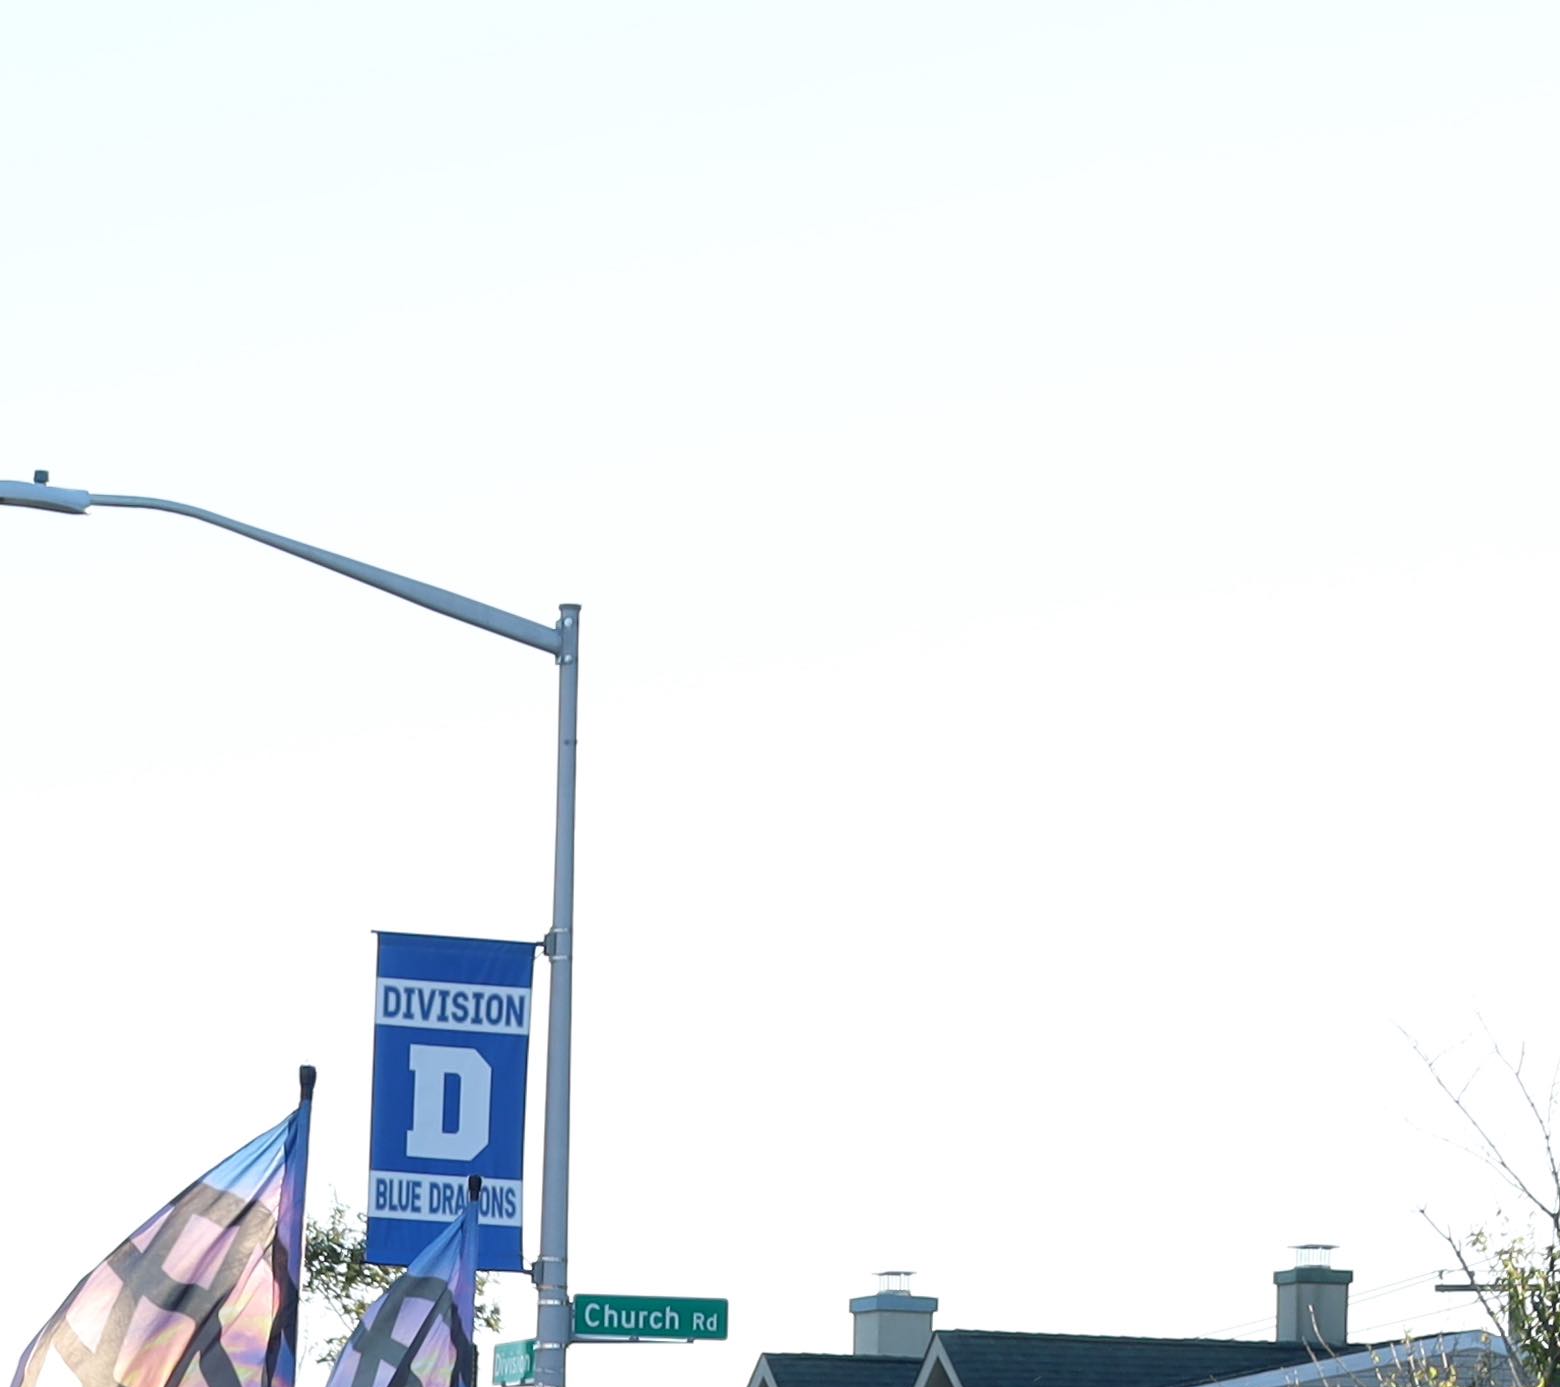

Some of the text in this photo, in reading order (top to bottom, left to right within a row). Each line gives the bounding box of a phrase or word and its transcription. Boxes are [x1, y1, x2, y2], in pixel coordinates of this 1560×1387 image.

[382, 984, 526, 1028] DIVISION
[406, 1043, 492, 1161] D
[374, 1177, 422, 1213] BLUE
[584, 1303, 718, 1332] Church Rd
[495, 1353, 530, 1376] Division
